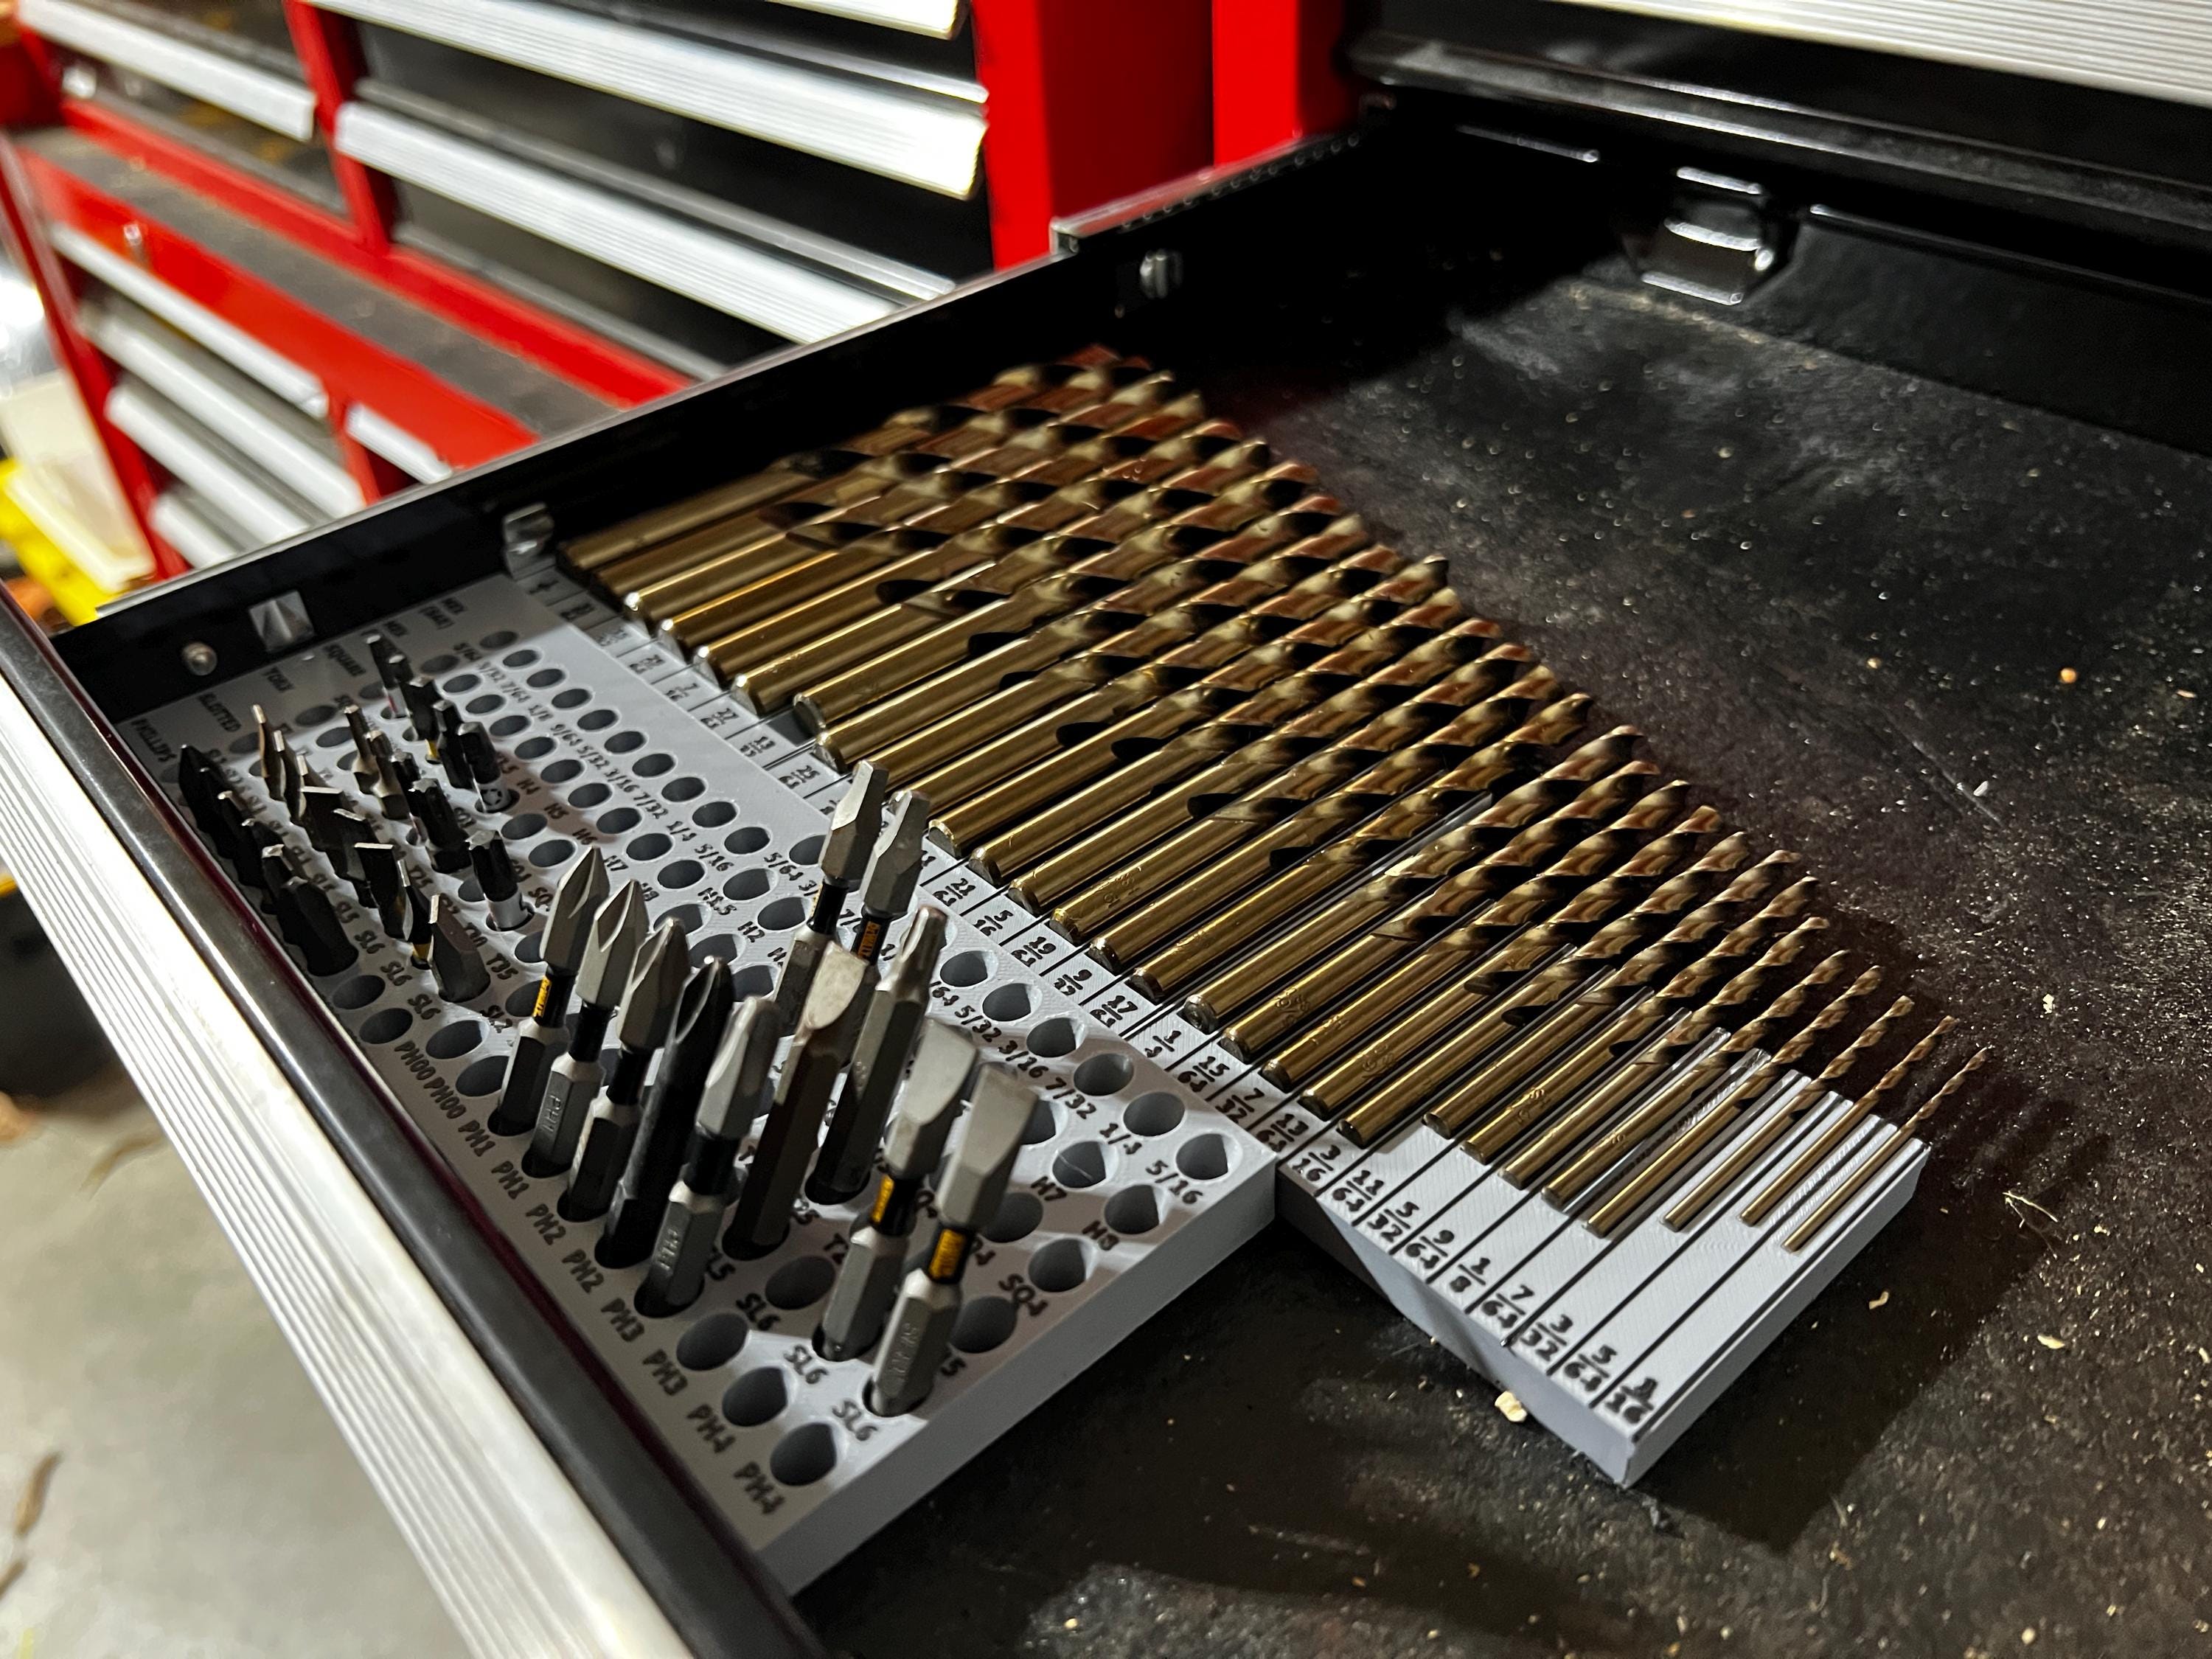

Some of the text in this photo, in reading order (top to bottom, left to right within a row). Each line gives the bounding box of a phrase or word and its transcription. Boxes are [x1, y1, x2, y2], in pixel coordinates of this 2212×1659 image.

[605, 768, 640, 793] 3/16
[634, 792, 668, 819] 7/32
[573, 828, 598, 845] H6
[667, 821, 697, 841] 1/4
[604, 855, 628, 872] H7
[695, 844, 734, 872] 5/16
[764, 852, 804, 880] 5/64
[737, 921, 765, 943] H2
[380, 961, 413, 987] SL6
[408, 994, 441, 1020] SL6
[955, 1005, 1001, 1043] 5/32
[394, 1040, 435, 1081] PH00
[998, 1040, 1049, 1078] 3/16
[423, 1077, 466, 1119] PH00
[1046, 1077, 1096, 1119] 7/32
[459, 1120, 495, 1157] PH1
[1100, 1123, 1142, 1155] 1/4
[491, 1161, 529, 1200] PH1
[1032, 1176, 1068, 1201] H7
[1146, 1161, 1203, 1204] 5/16
[525, 1203, 566, 1245] PH2
[562, 1249, 604, 1293] PH2
[736, 1293, 781, 1331] SL6
[998, 1273, 1048, 1317] SQ4
[601, 1298, 645, 1342] PH3
[642, 1349, 688, 1396] PH3
[783, 1345, 829, 1384] SL6
[686, 1404, 736, 1454] PH4
[832, 1399, 878, 1441] SL6
[734, 1461, 785, 1514] PH4
